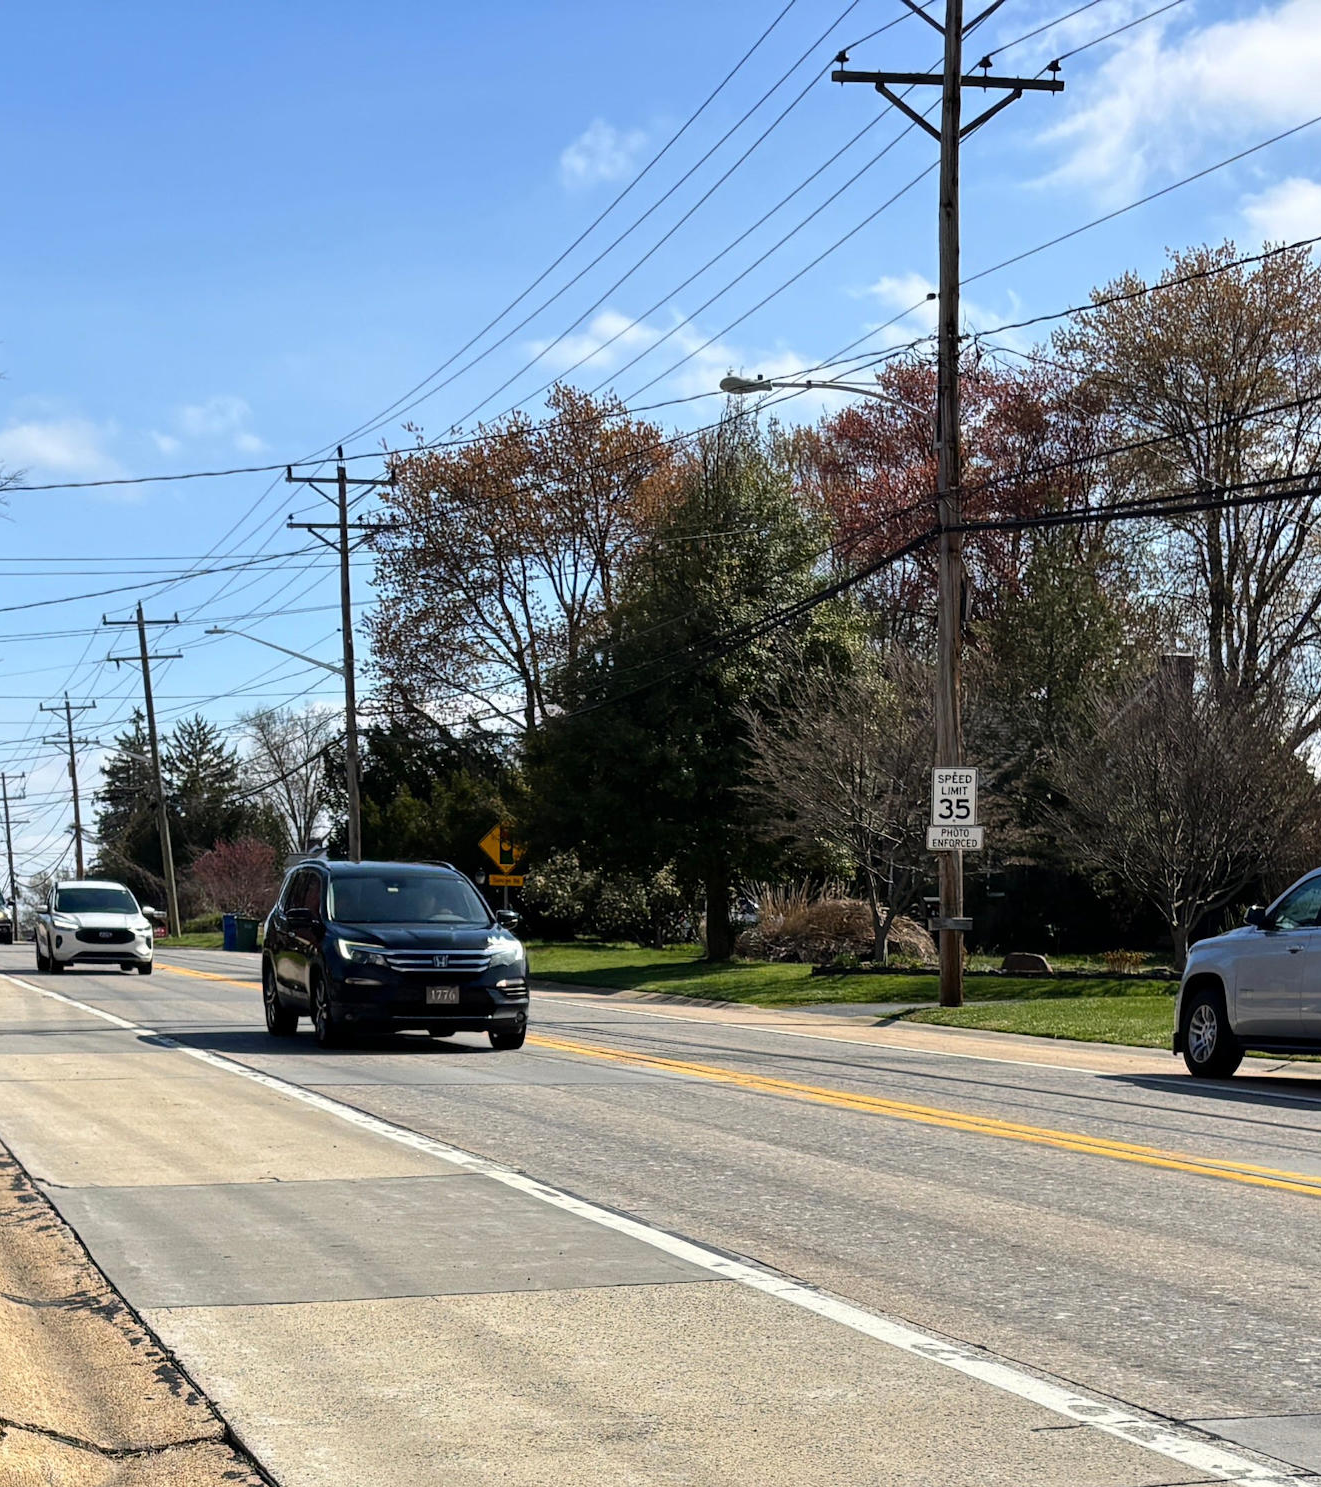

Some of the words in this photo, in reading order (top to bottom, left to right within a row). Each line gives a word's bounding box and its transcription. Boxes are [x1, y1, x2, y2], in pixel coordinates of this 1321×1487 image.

[938, 774, 972, 784] SPEED
[941, 786, 968, 796] LIMIT
[938, 798, 971, 820] 35
[941, 828, 969, 838] PHOTO
[932, 839, 978, 848] ENFORCED
[431, 989, 456, 1001] 1776
